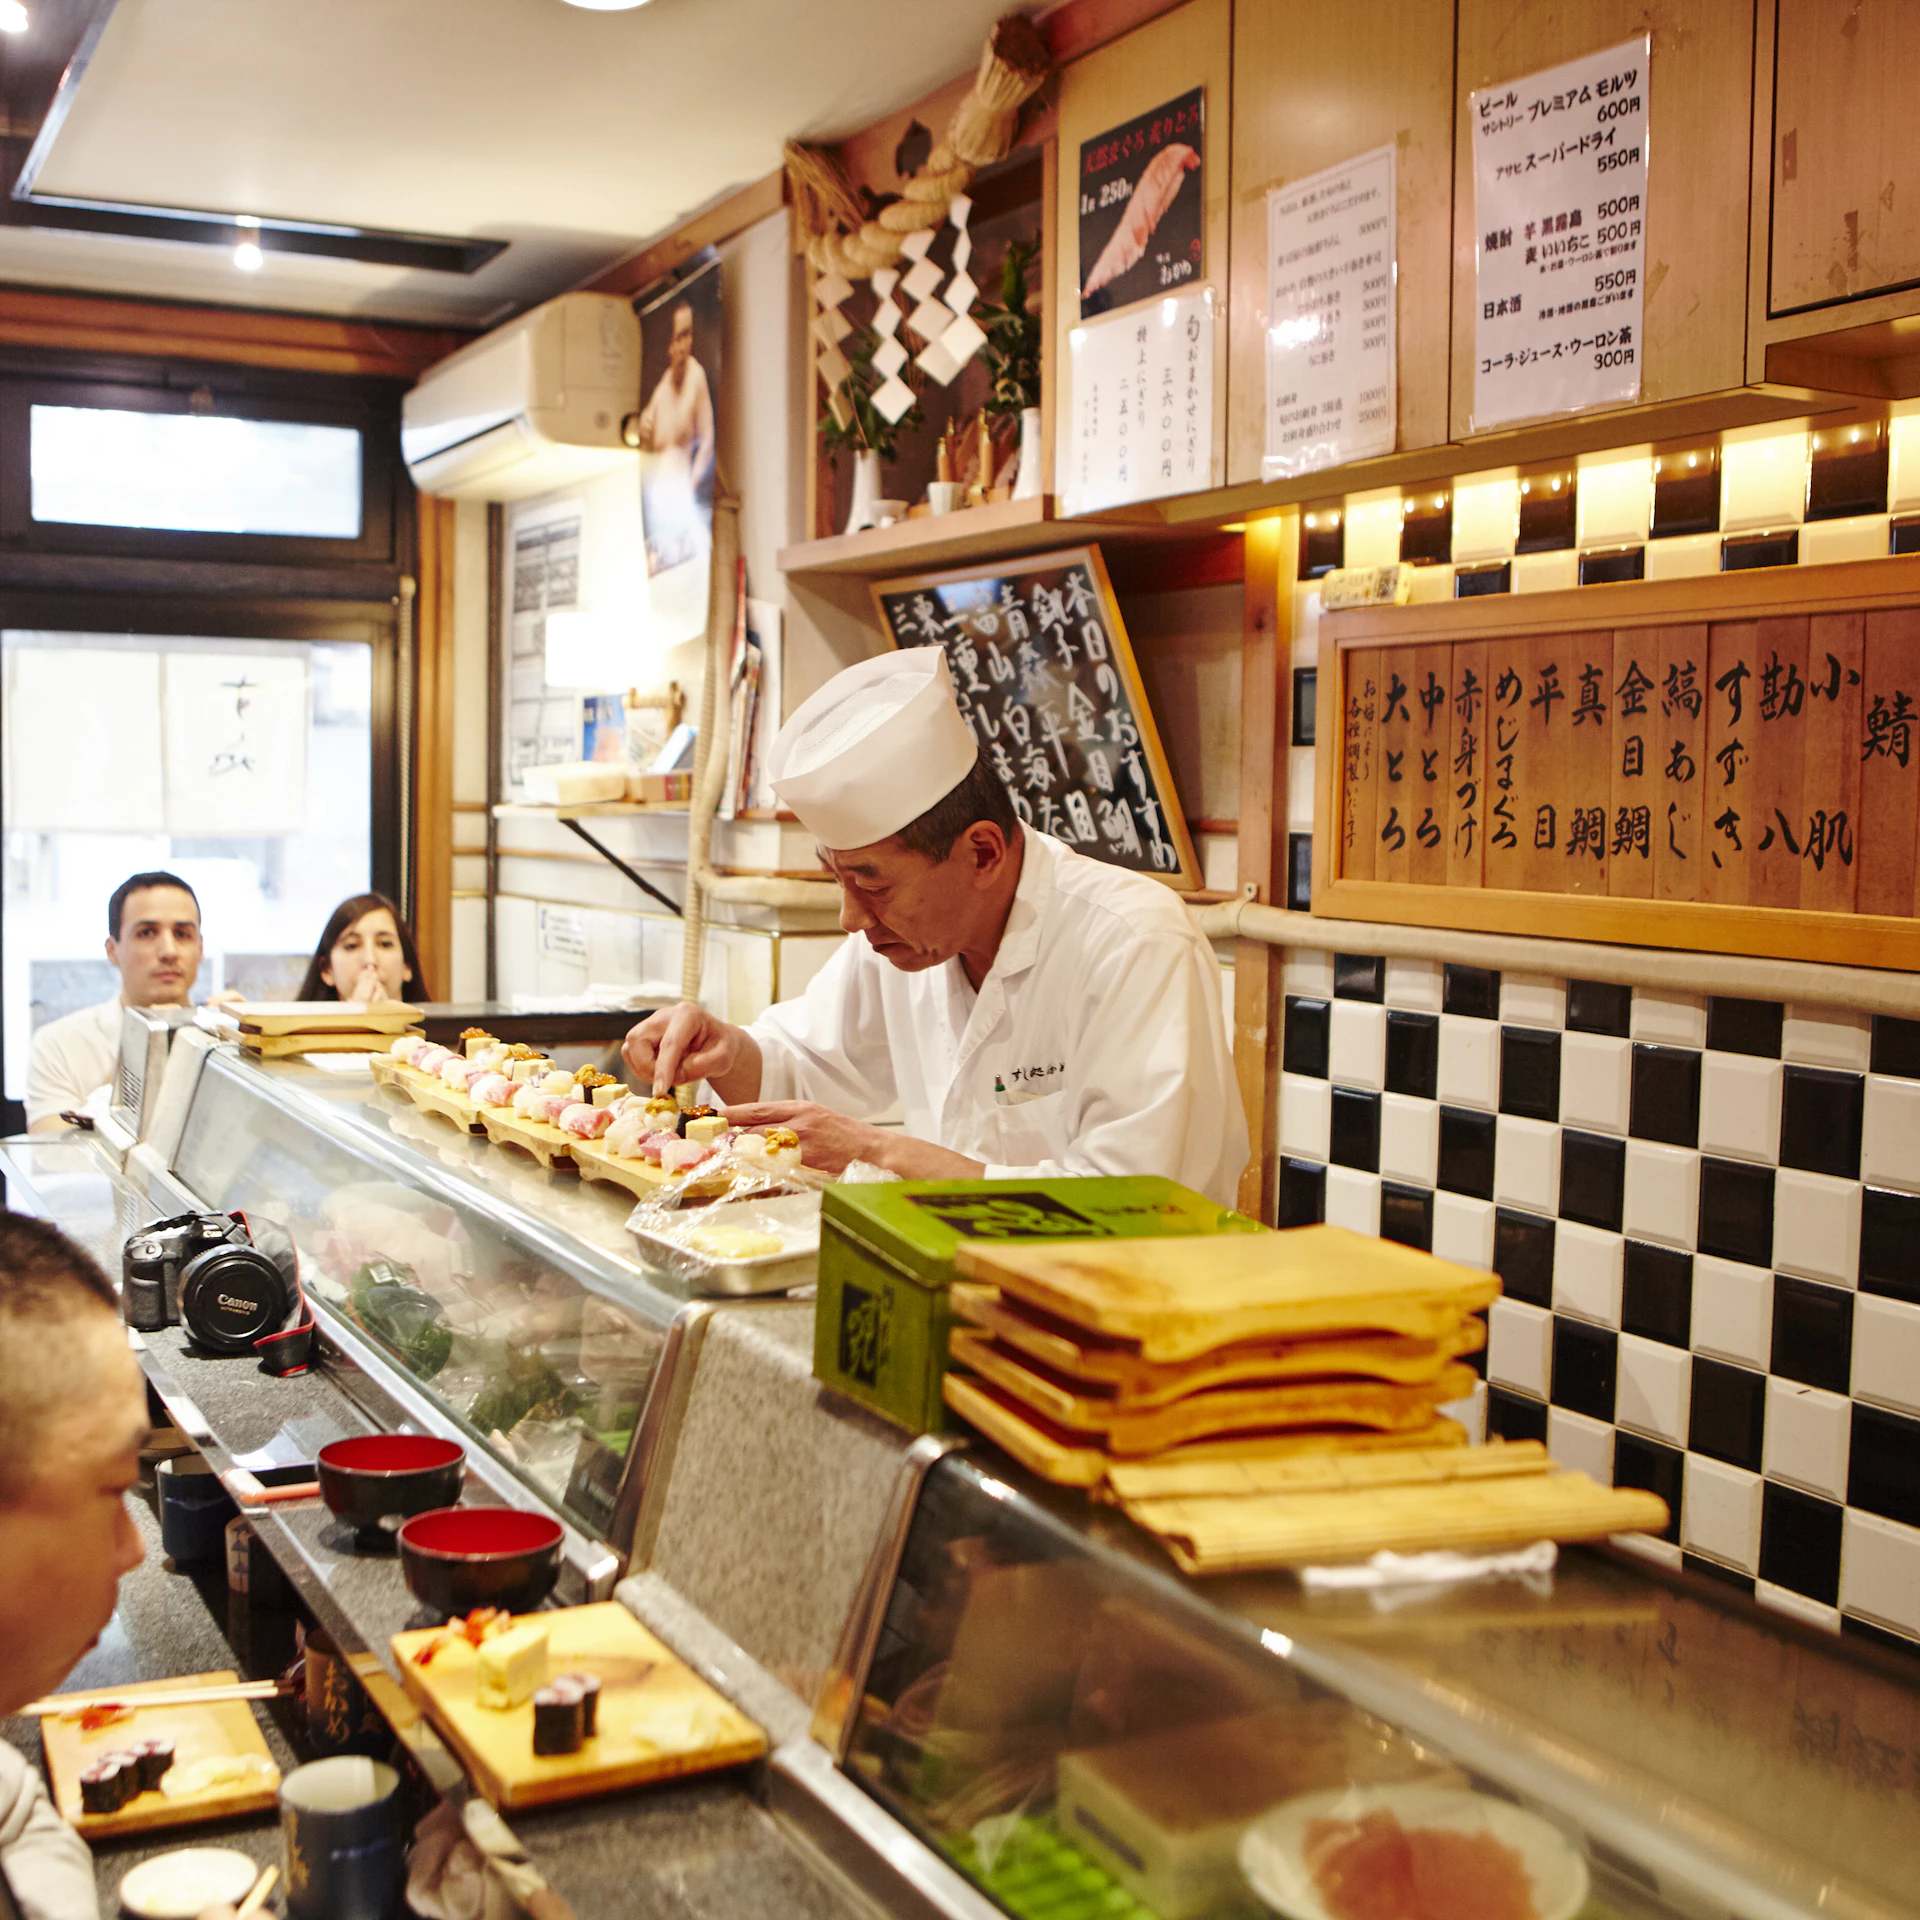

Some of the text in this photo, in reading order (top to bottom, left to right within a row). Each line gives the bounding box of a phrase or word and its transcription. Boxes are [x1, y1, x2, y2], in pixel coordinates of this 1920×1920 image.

[1479, 91, 1518, 119] ビール
[1482, 115, 1524, 137] サントリー
[1525, 126, 1617, 171] スーパードライ
[1597, 96, 1640, 124] 600円
[1597, 147, 1640, 174] 550円
[1485, 228, 1513, 253] 焼酎
[1541, 209, 1582, 236] 黒霧島
[1597, 195, 1640, 221] 500円
[1525, 220, 1641, 265] 麦 いいちこ 500円
[1594, 268, 1636, 292] 550円
[1483, 294, 1522, 319] 日本酒
[1593, 348, 1635, 371] 300円
[1064, 570, 1177, 871] 本日のおすすめ
[1380, 672, 1412, 853] 大とろ
[1414, 671, 1447, 853] 中とろ
[1452, 667, 1484, 860] 赤身づけ
[1489, 667, 1523, 851] めじまぐろ
[1528, 669, 1566, 851] 平目
[1565, 662, 1608, 862] 真鯛
[1610, 659, 1654, 858] 金目鯛
[1711, 659, 1752, 869] すずき
[1757, 651, 1803, 857] 勘八
[1803, 652, 1861, 872] 小肌
[217, 1293, 258, 1312] Canon
